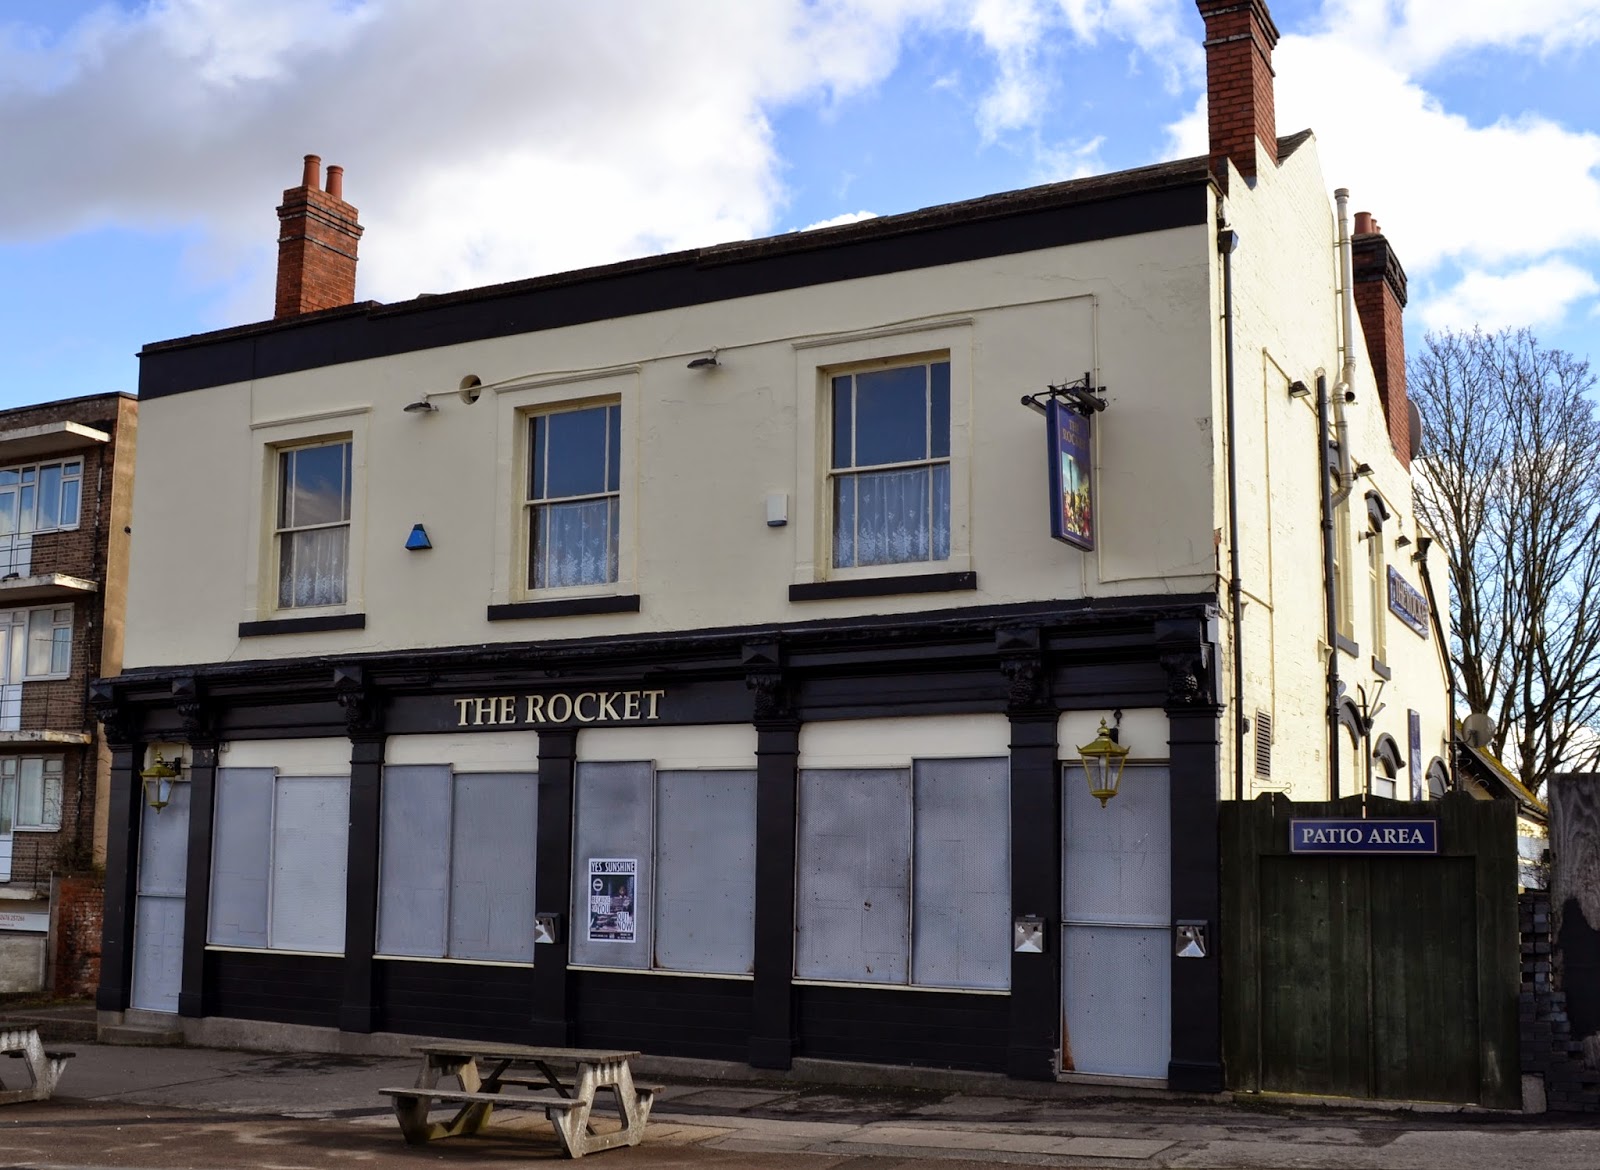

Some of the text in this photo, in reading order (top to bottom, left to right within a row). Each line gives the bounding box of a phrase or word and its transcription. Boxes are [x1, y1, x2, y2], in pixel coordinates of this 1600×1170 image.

[454, 689, 665, 726] THE ROCKET
[1302, 828, 1426, 844] PATIO AREA
[591, 861, 635, 872] YES SUNSHINE
[598, 904, 610, 914] YOU
[617, 912, 629, 921] OUT
[617, 921, 634, 931] NOW
